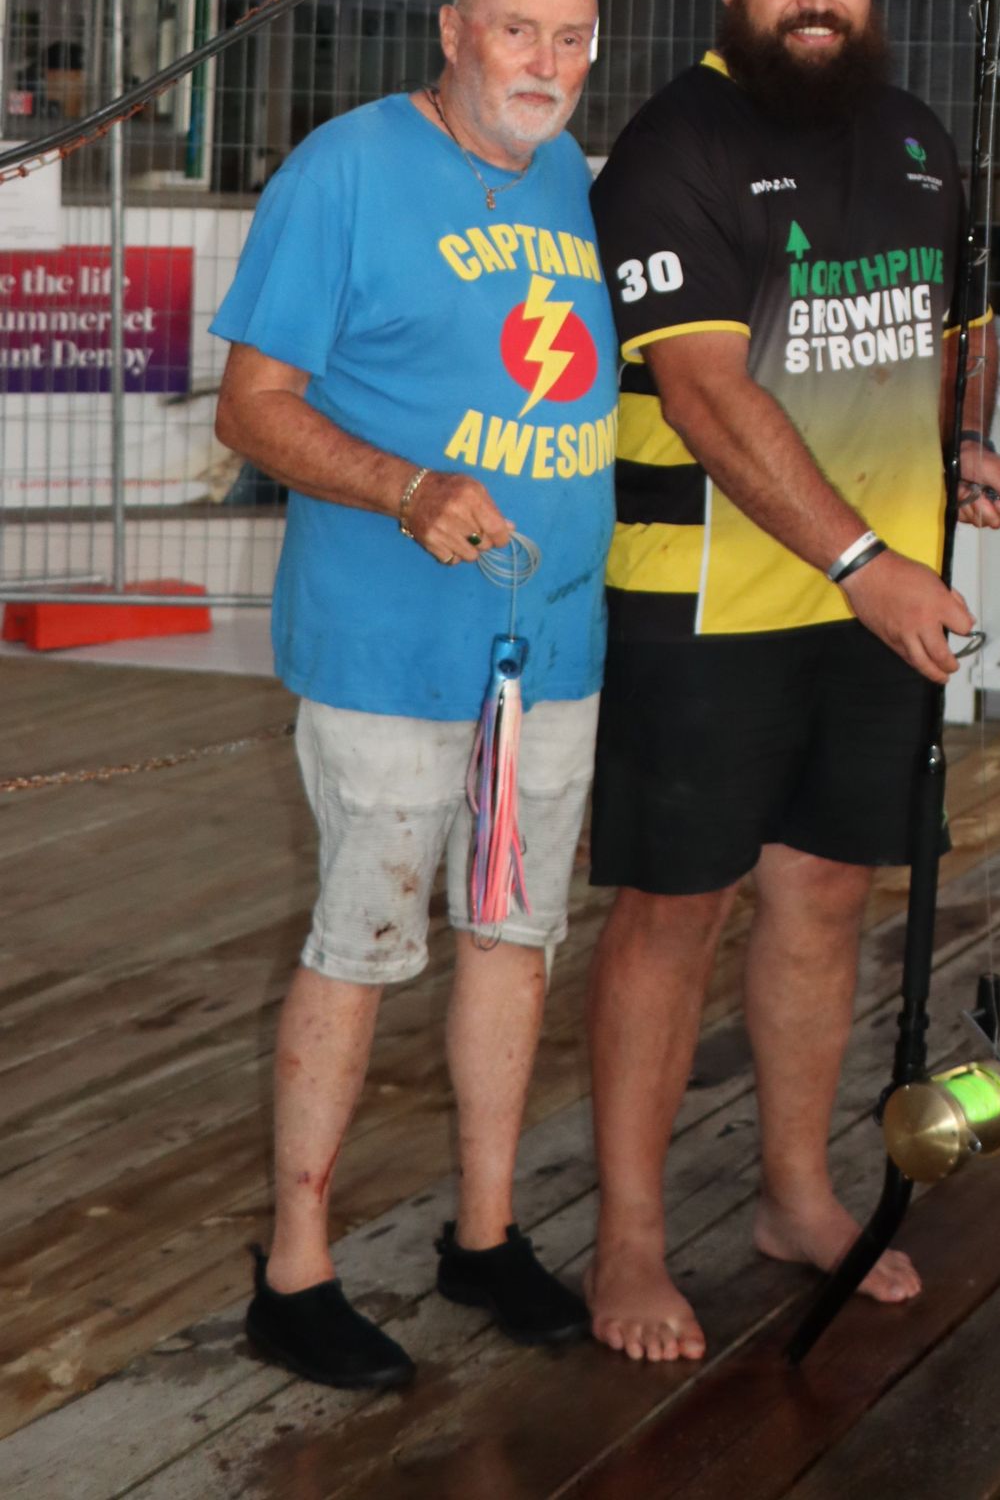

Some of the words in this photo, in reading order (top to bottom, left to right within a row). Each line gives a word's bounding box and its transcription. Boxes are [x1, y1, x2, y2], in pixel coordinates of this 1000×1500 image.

[438, 223, 603, 283] CAPTAIN
[617, 250, 684, 304] 30
[22, 265, 74, 296] the
[0, 307, 156, 333] ummeret
[788, 284, 932, 336] GROWING
[785, 322, 935, 375] STRONGE
[444, 405, 621, 480] AWESOM
